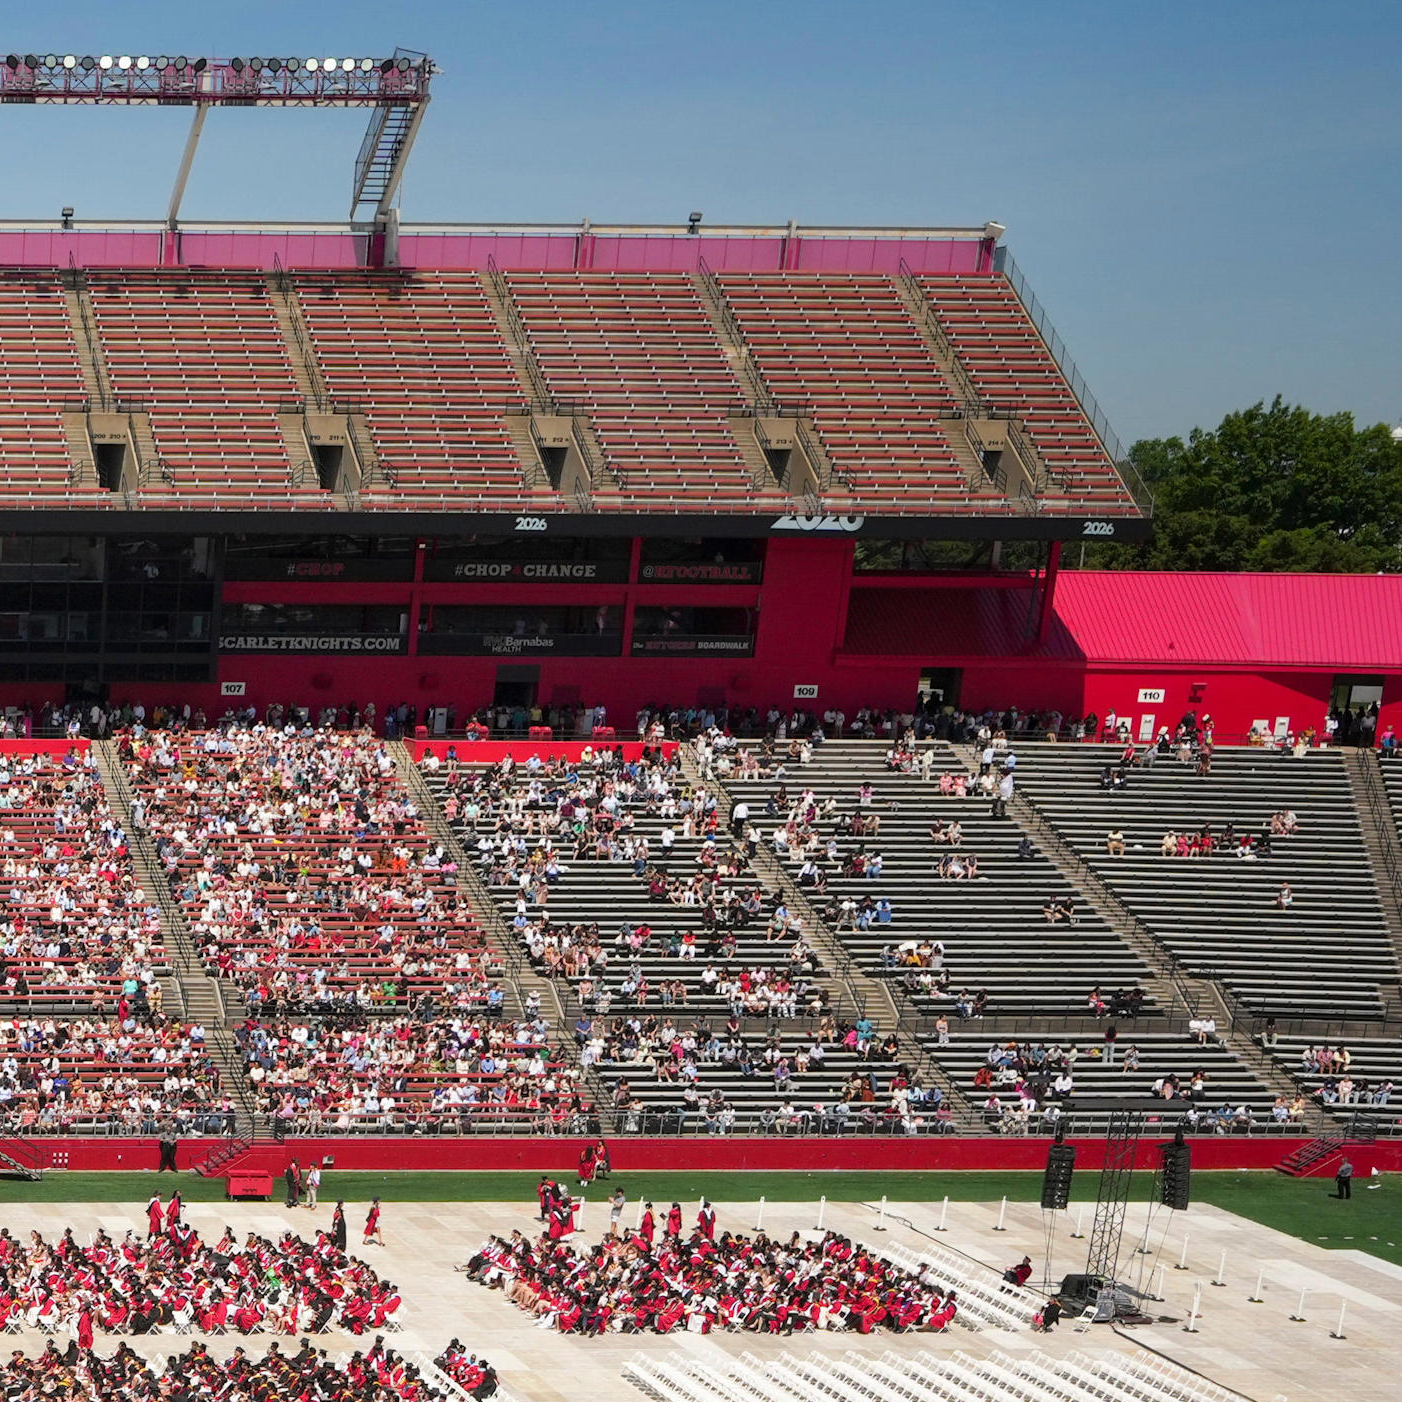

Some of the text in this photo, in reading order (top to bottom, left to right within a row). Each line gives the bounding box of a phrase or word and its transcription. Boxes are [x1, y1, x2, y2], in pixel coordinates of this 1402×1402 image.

[515, 517, 548, 532] 2026
[1082, 521, 1115, 536] 2026
[218, 636, 400, 650] SCARLETKNIGHTS.COM
[698, 641, 749, 649] BOARDWALK
[225, 684, 243, 693] 107
[797, 687, 815, 696] 109
[1143, 692, 1160, 700] 110
